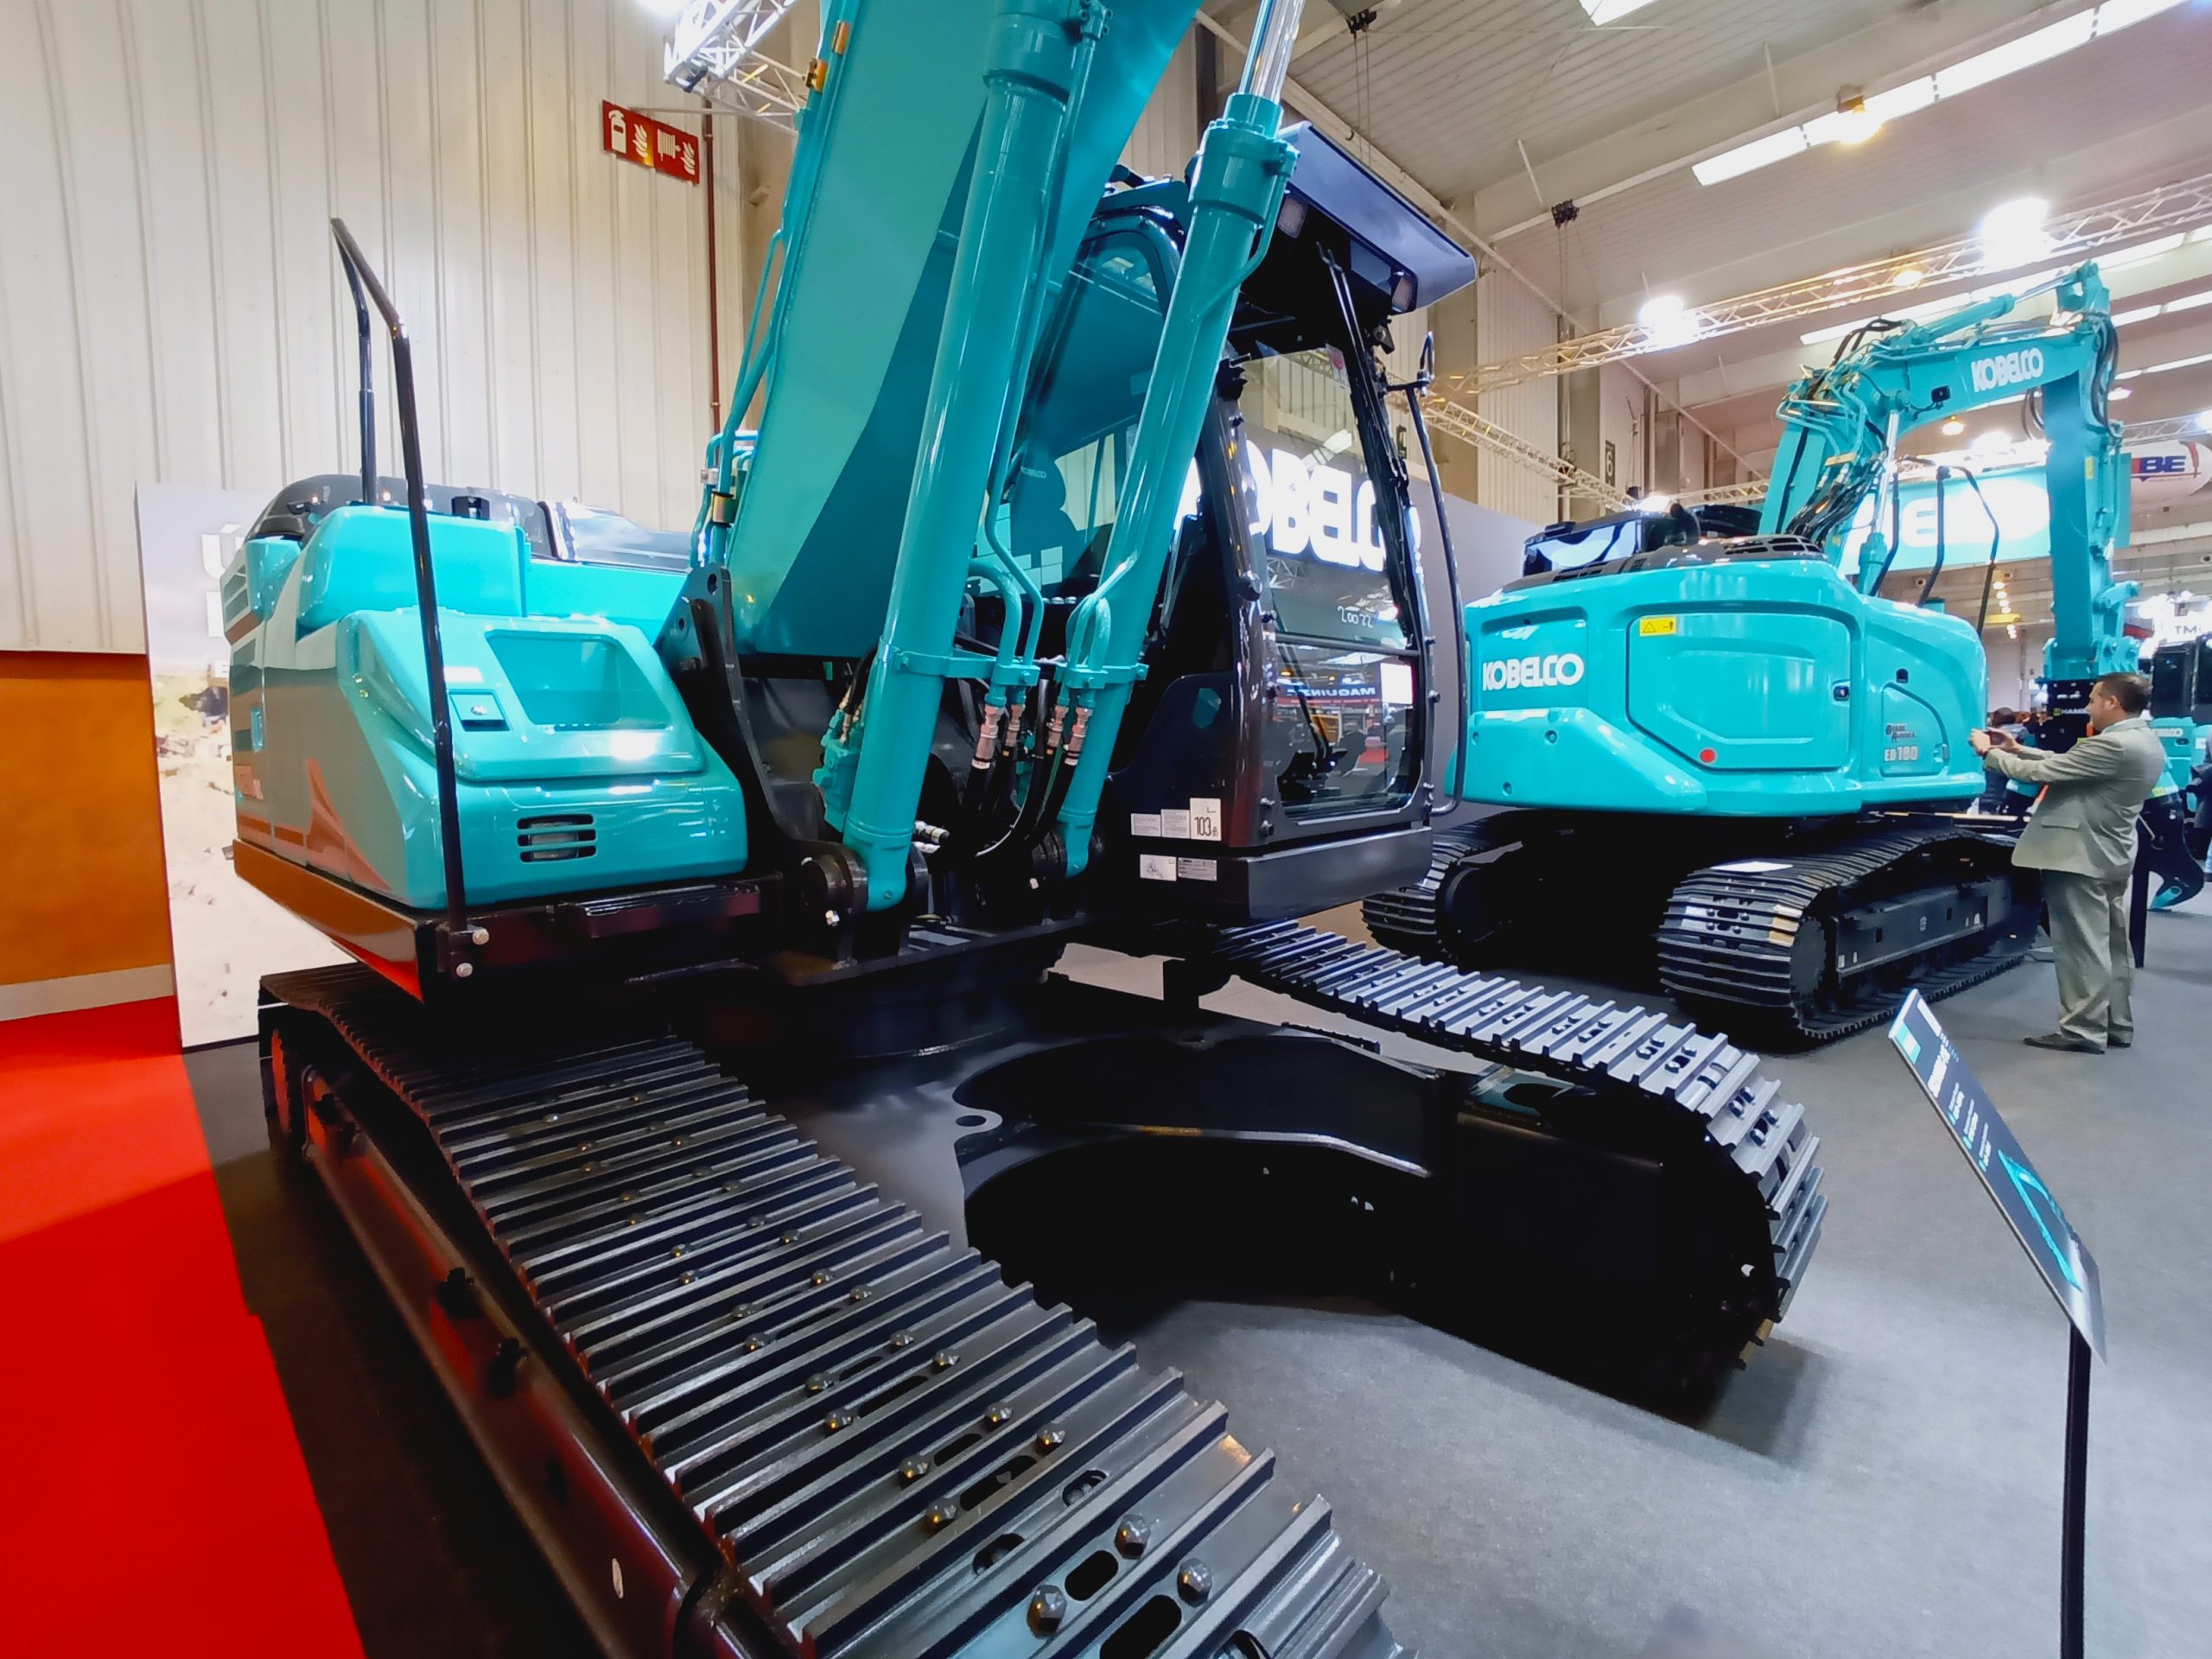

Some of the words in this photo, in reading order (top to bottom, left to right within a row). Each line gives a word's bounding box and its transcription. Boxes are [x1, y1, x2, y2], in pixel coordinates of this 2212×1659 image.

[1971, 347, 2044, 392] KOBELCO
[1607, 451, 1613, 477] 6
[2175, 625, 2202, 634] TM
[1482, 652, 1585, 691] KOBELCO
[1194, 817, 1211, 836] 103
